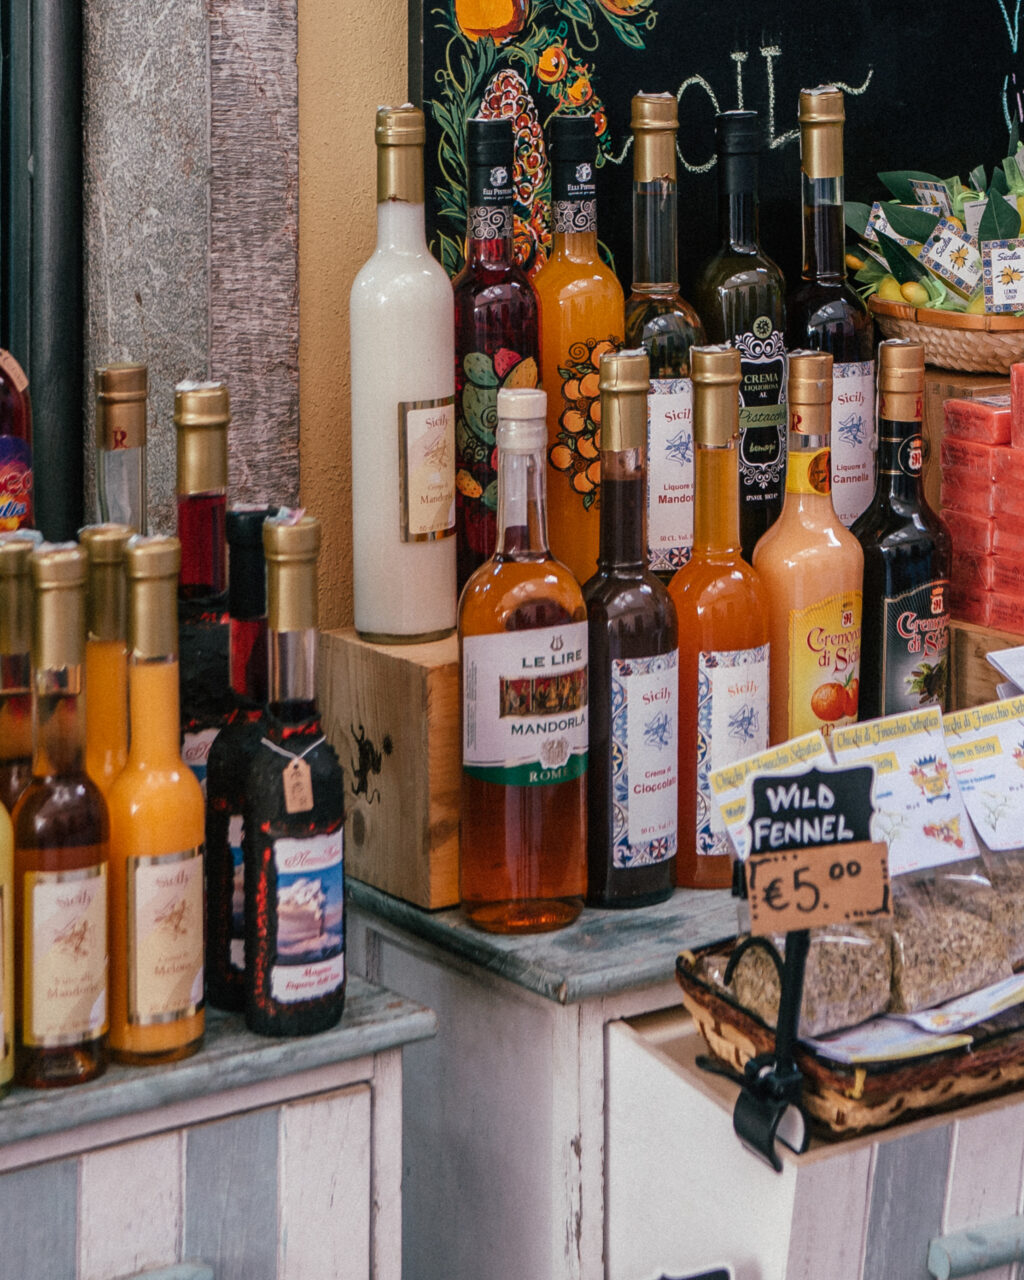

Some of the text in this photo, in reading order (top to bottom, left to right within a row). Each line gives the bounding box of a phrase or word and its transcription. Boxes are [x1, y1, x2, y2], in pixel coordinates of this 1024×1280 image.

[996, 251, 1022, 262] Sicilia
[743, 372, 779, 385] CREMA
[837, 391, 866, 407] Sicily
[664, 408, 692, 424] Sicil
[832, 472, 869, 484] Cannella
[836, 464, 860, 473] Liquore
[663, 483, 690, 492] Liquore
[657, 494, 695, 505] Mandor
[907, 633, 922, 654] di
[521, 648, 583, 669] LE LIRE
[817, 649, 831, 668] di
[641, 687, 672, 706] Sicily
[726, 680, 762, 699] Sicily
[510, 713, 587, 736] MANDORLA
[765, 782, 836, 813] WILD
[753, 814, 855, 849] FENNEL
[761, 860, 862, 915] €5.00
